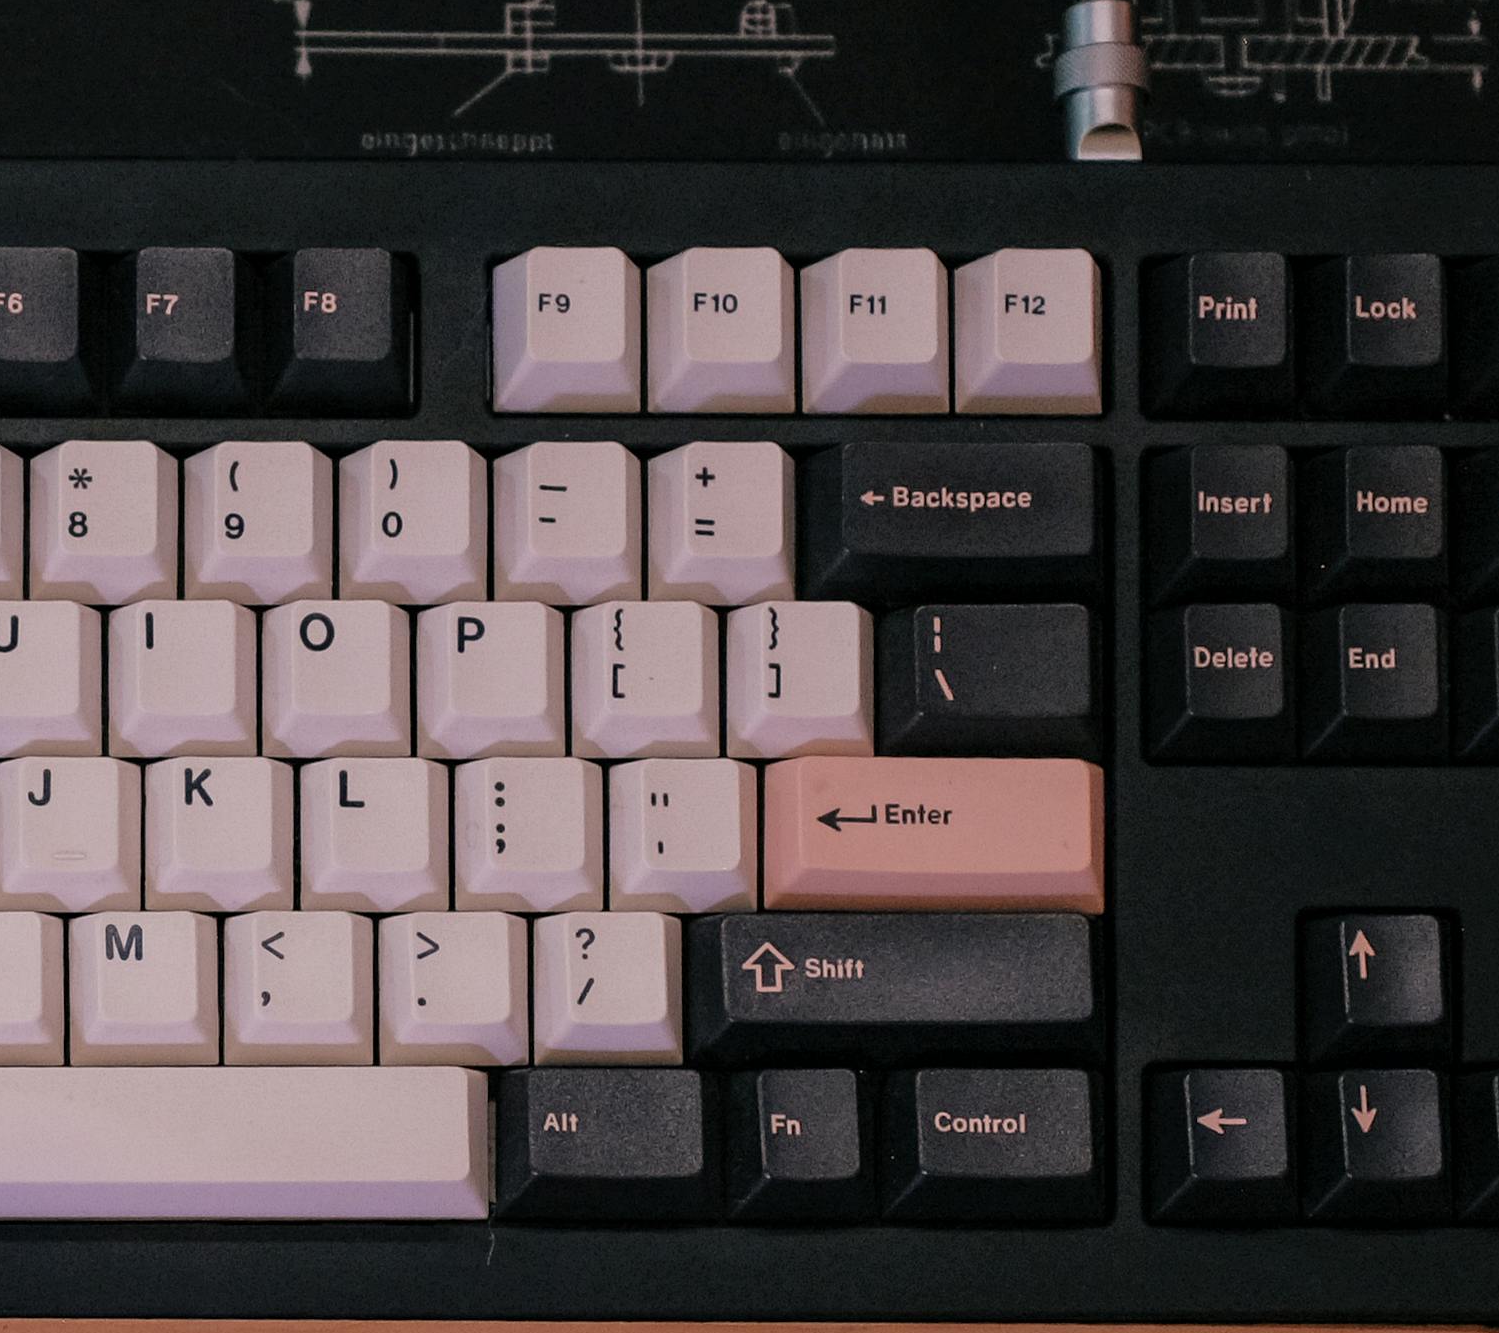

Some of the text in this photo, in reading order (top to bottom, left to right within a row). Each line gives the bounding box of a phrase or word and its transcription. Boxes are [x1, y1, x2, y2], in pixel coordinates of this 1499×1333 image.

[146, 293, 179, 316] F7
[303, 291, 337, 314] F8
[537, 292, 571, 314] F9
[693, 292, 739, 314] F10
[849, 293, 887, 315] F11
[1004, 293, 1046, 316] F12
[1199, 295, 1258, 321] Print
[1355, 296, 1417, 320] Lock
[892, 485, 1032, 513] Backspace
[1198, 491, 1272, 514] Insert
[1356, 491, 1428, 514] Home
[67, 511, 89, 538] 8
[224, 512, 245, 540] 9
[381, 511, 403, 538] 0
[145, 612, 155, 650] I
[299, 612, 335, 652] O
[457, 616, 486, 654] P
[1194, 646, 1274, 669] Delete
[1348, 647, 1396, 669] End
[27, 768, 52, 807] J
[184, 767, 214, 807] K
[338, 769, 365, 809] L
[884, 803, 953, 825] Enter
[105, 924, 144, 961] M
[804, 957, 864, 979] Shift
[543, 1112, 578, 1132] Alt
[770, 1113, 801, 1136] Fn
[934, 1111, 1026, 1134] Control
